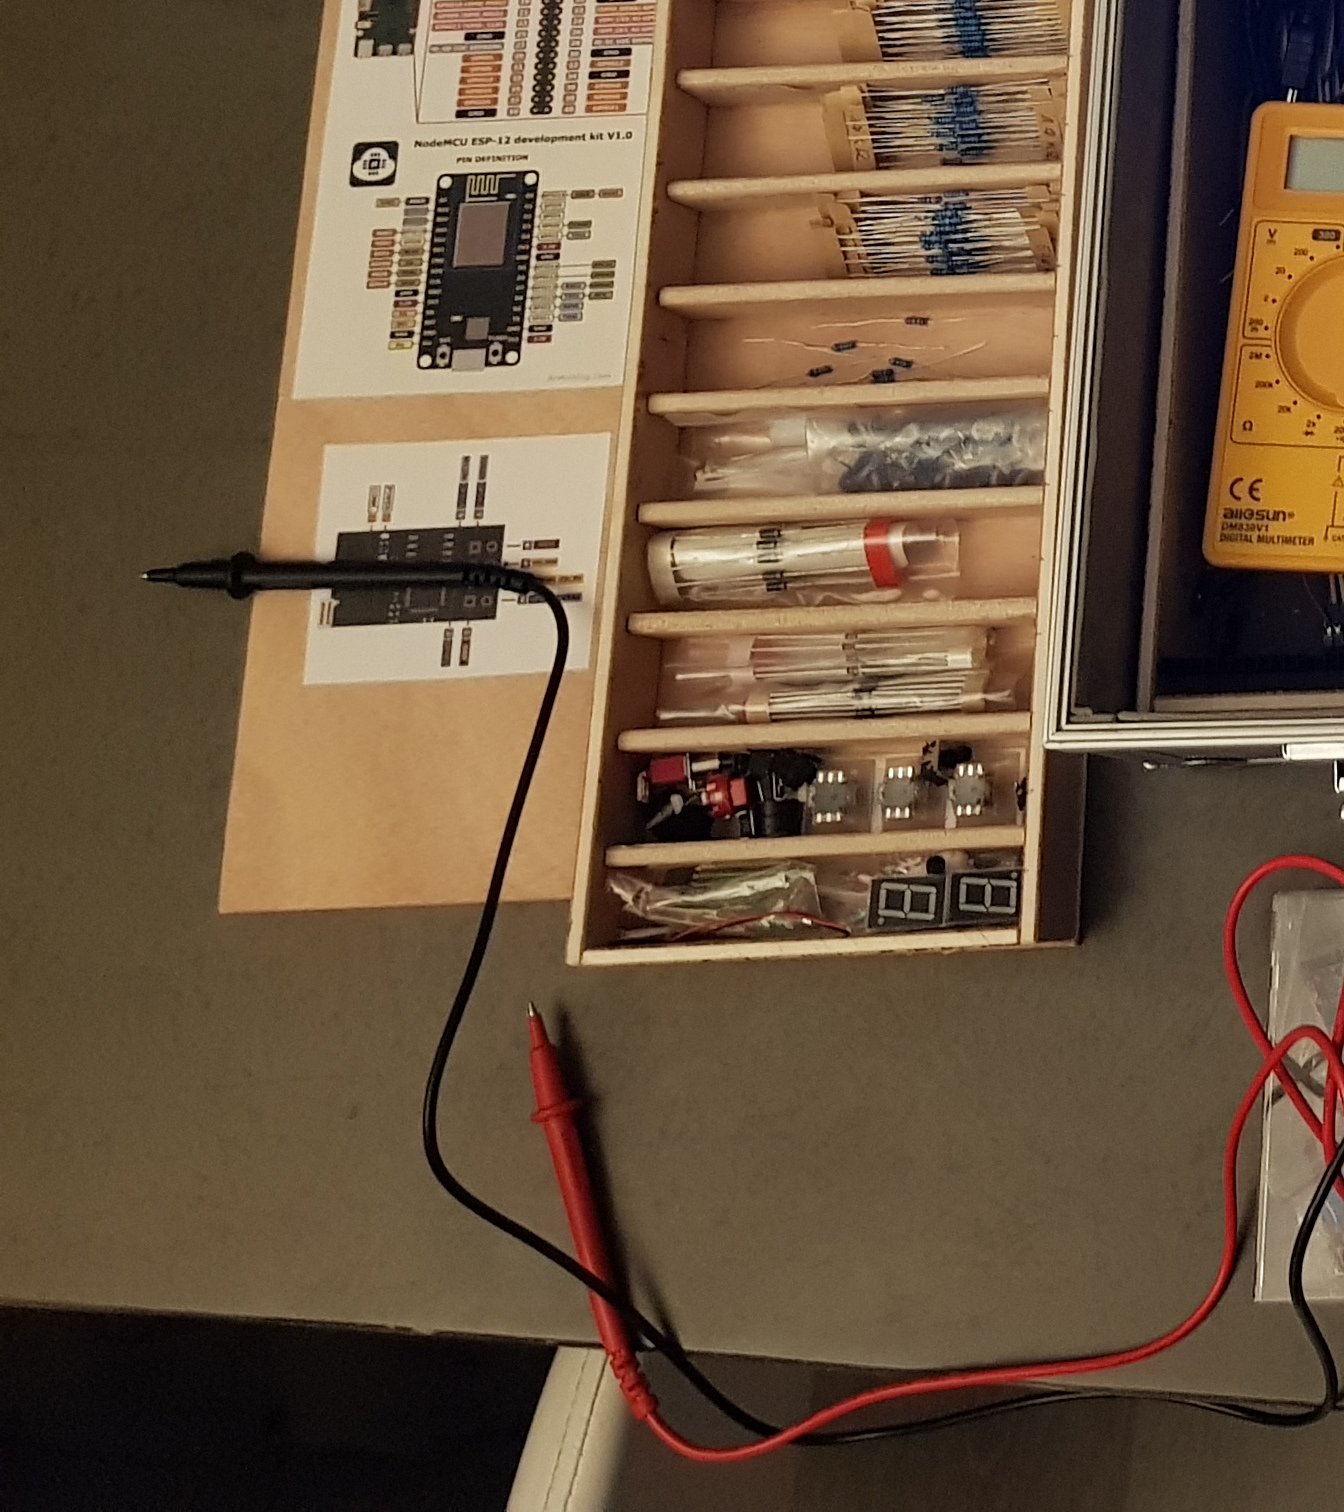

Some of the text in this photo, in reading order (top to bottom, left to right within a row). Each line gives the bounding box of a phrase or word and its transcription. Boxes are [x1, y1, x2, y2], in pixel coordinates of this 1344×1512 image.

[414, 130, 633, 148] NodeMCU ESP-12 development kit V1.0
[456, 154, 529, 164] PIN DEFINITION
[1268, 228, 1278, 239] V
[1219, 532, 1315, 546] DIGITAL MULTIMETER
